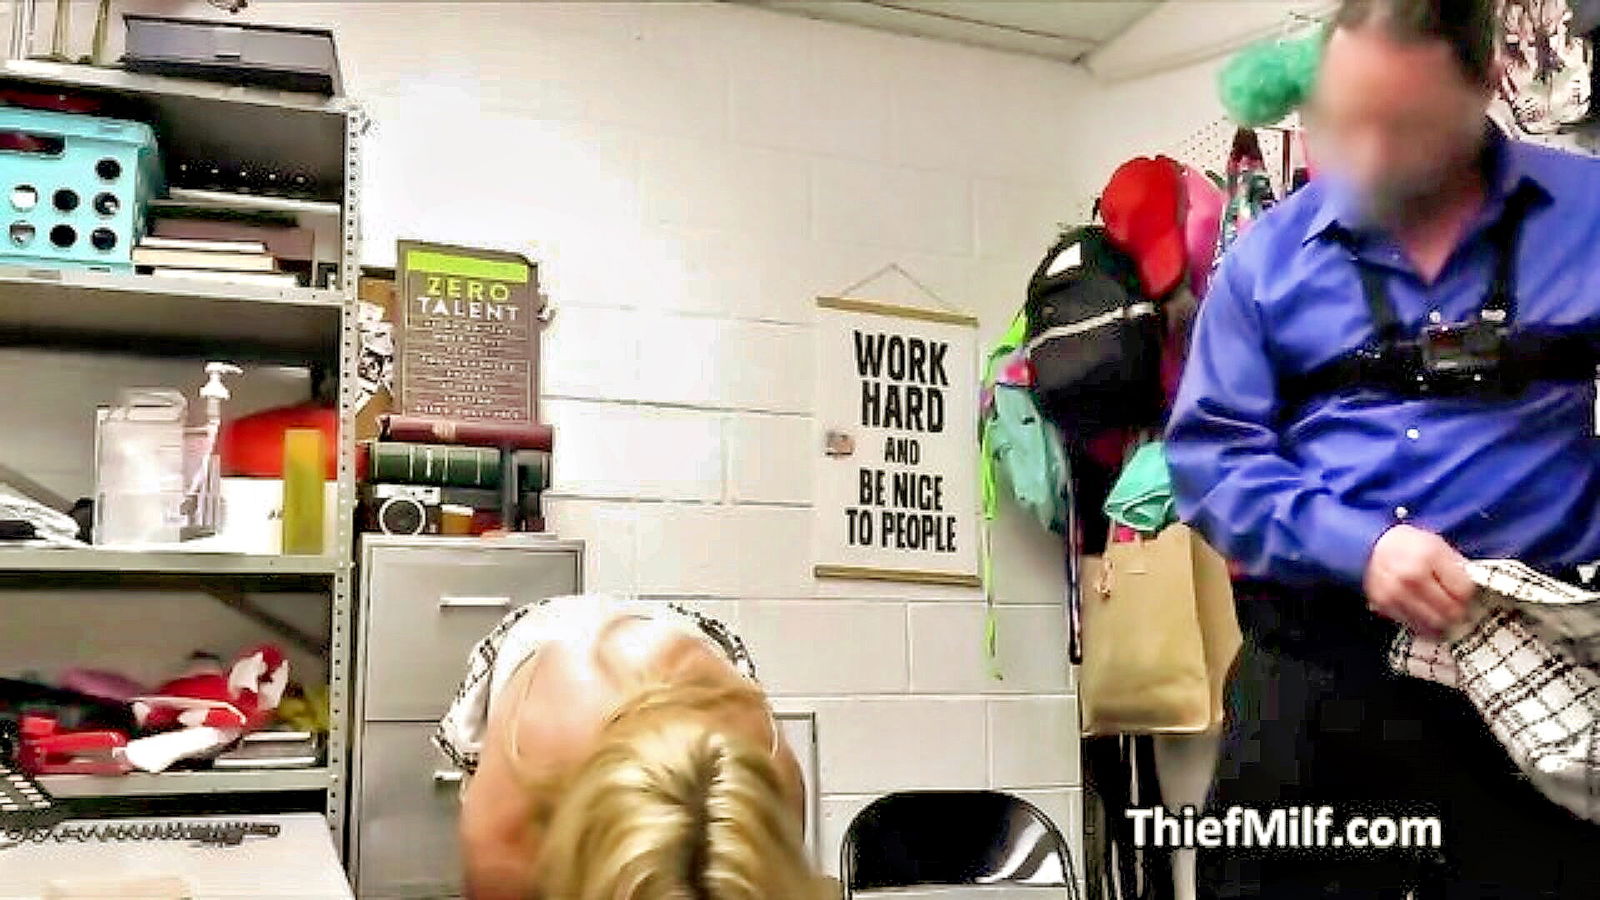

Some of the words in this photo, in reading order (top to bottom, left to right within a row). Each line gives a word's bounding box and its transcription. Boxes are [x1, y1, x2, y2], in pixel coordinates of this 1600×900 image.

[416, 298, 519, 321] TALENT
[427, 277, 509, 301] ZERO
[854, 330, 948, 386] WORK
[861, 381, 944, 433] HARD
[884, 437, 920, 465] AND
[859, 468, 886, 505] BE
[893, 472, 943, 511] NICE
[845, 509, 872, 545] TO
[882, 512, 957, 552] PEOPLE
